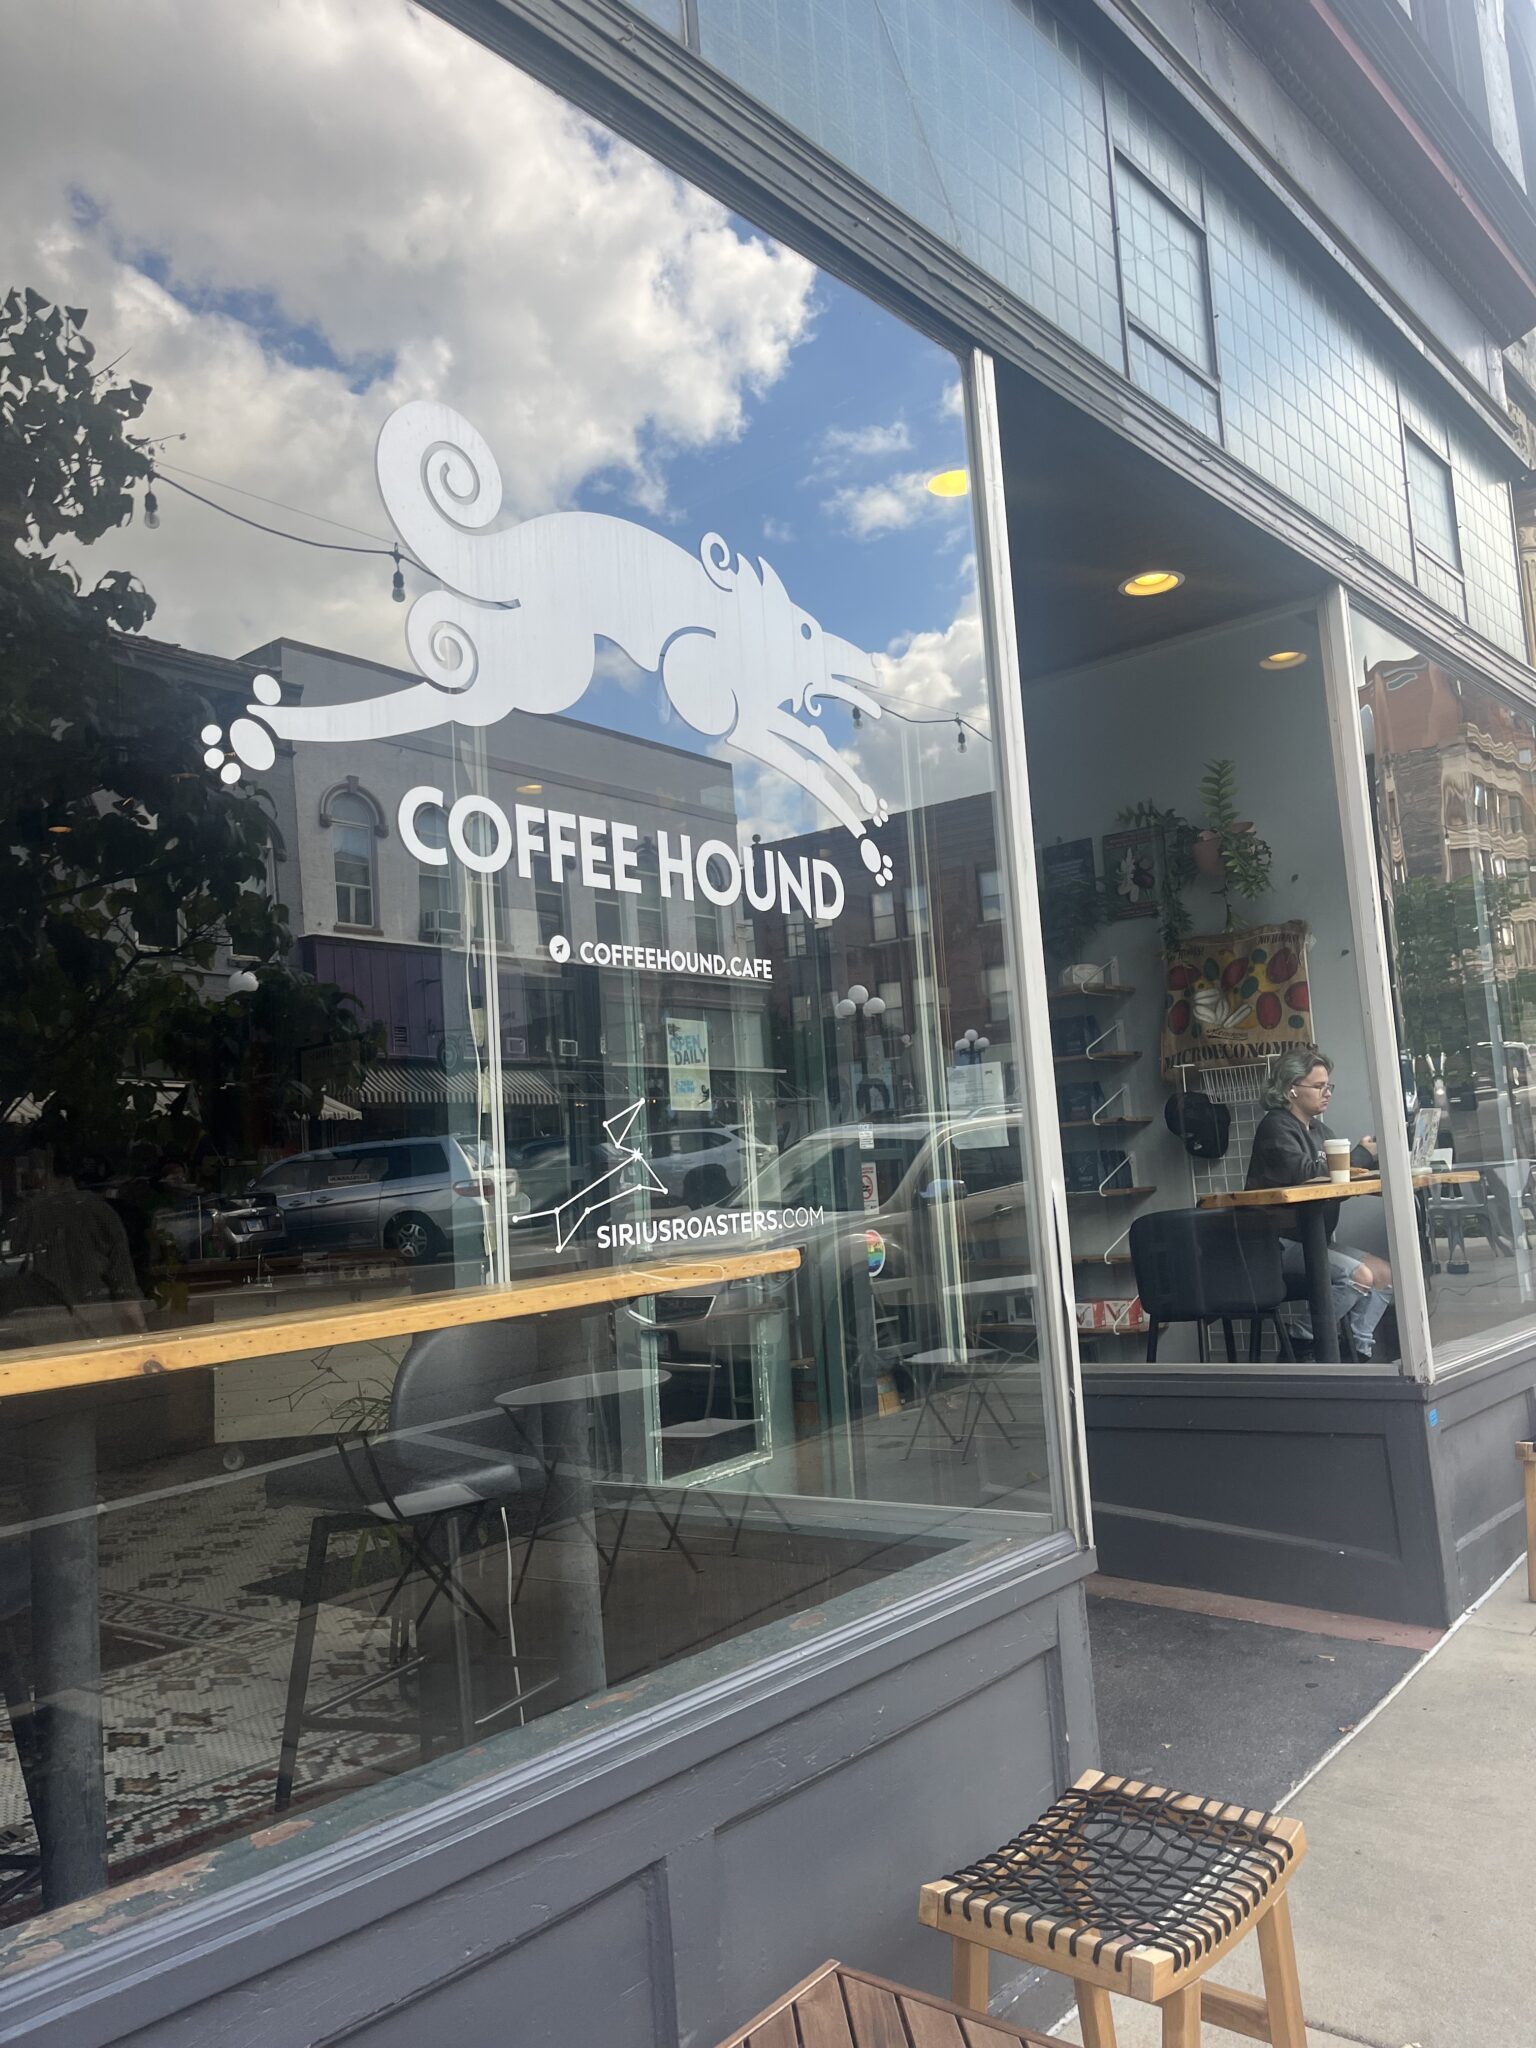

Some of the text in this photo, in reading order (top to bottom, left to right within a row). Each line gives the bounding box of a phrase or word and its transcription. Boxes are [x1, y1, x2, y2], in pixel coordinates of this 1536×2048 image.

[398, 785, 845, 920] COFFEE HOUND
[579, 941, 773, 979] COFFEEHOUND.CAFE
[670, 1034, 701, 1052] OPEN
[674, 1048, 707, 1066] DAILY
[596, 1205, 825, 1249] SIRIUSROASTERS.COM
